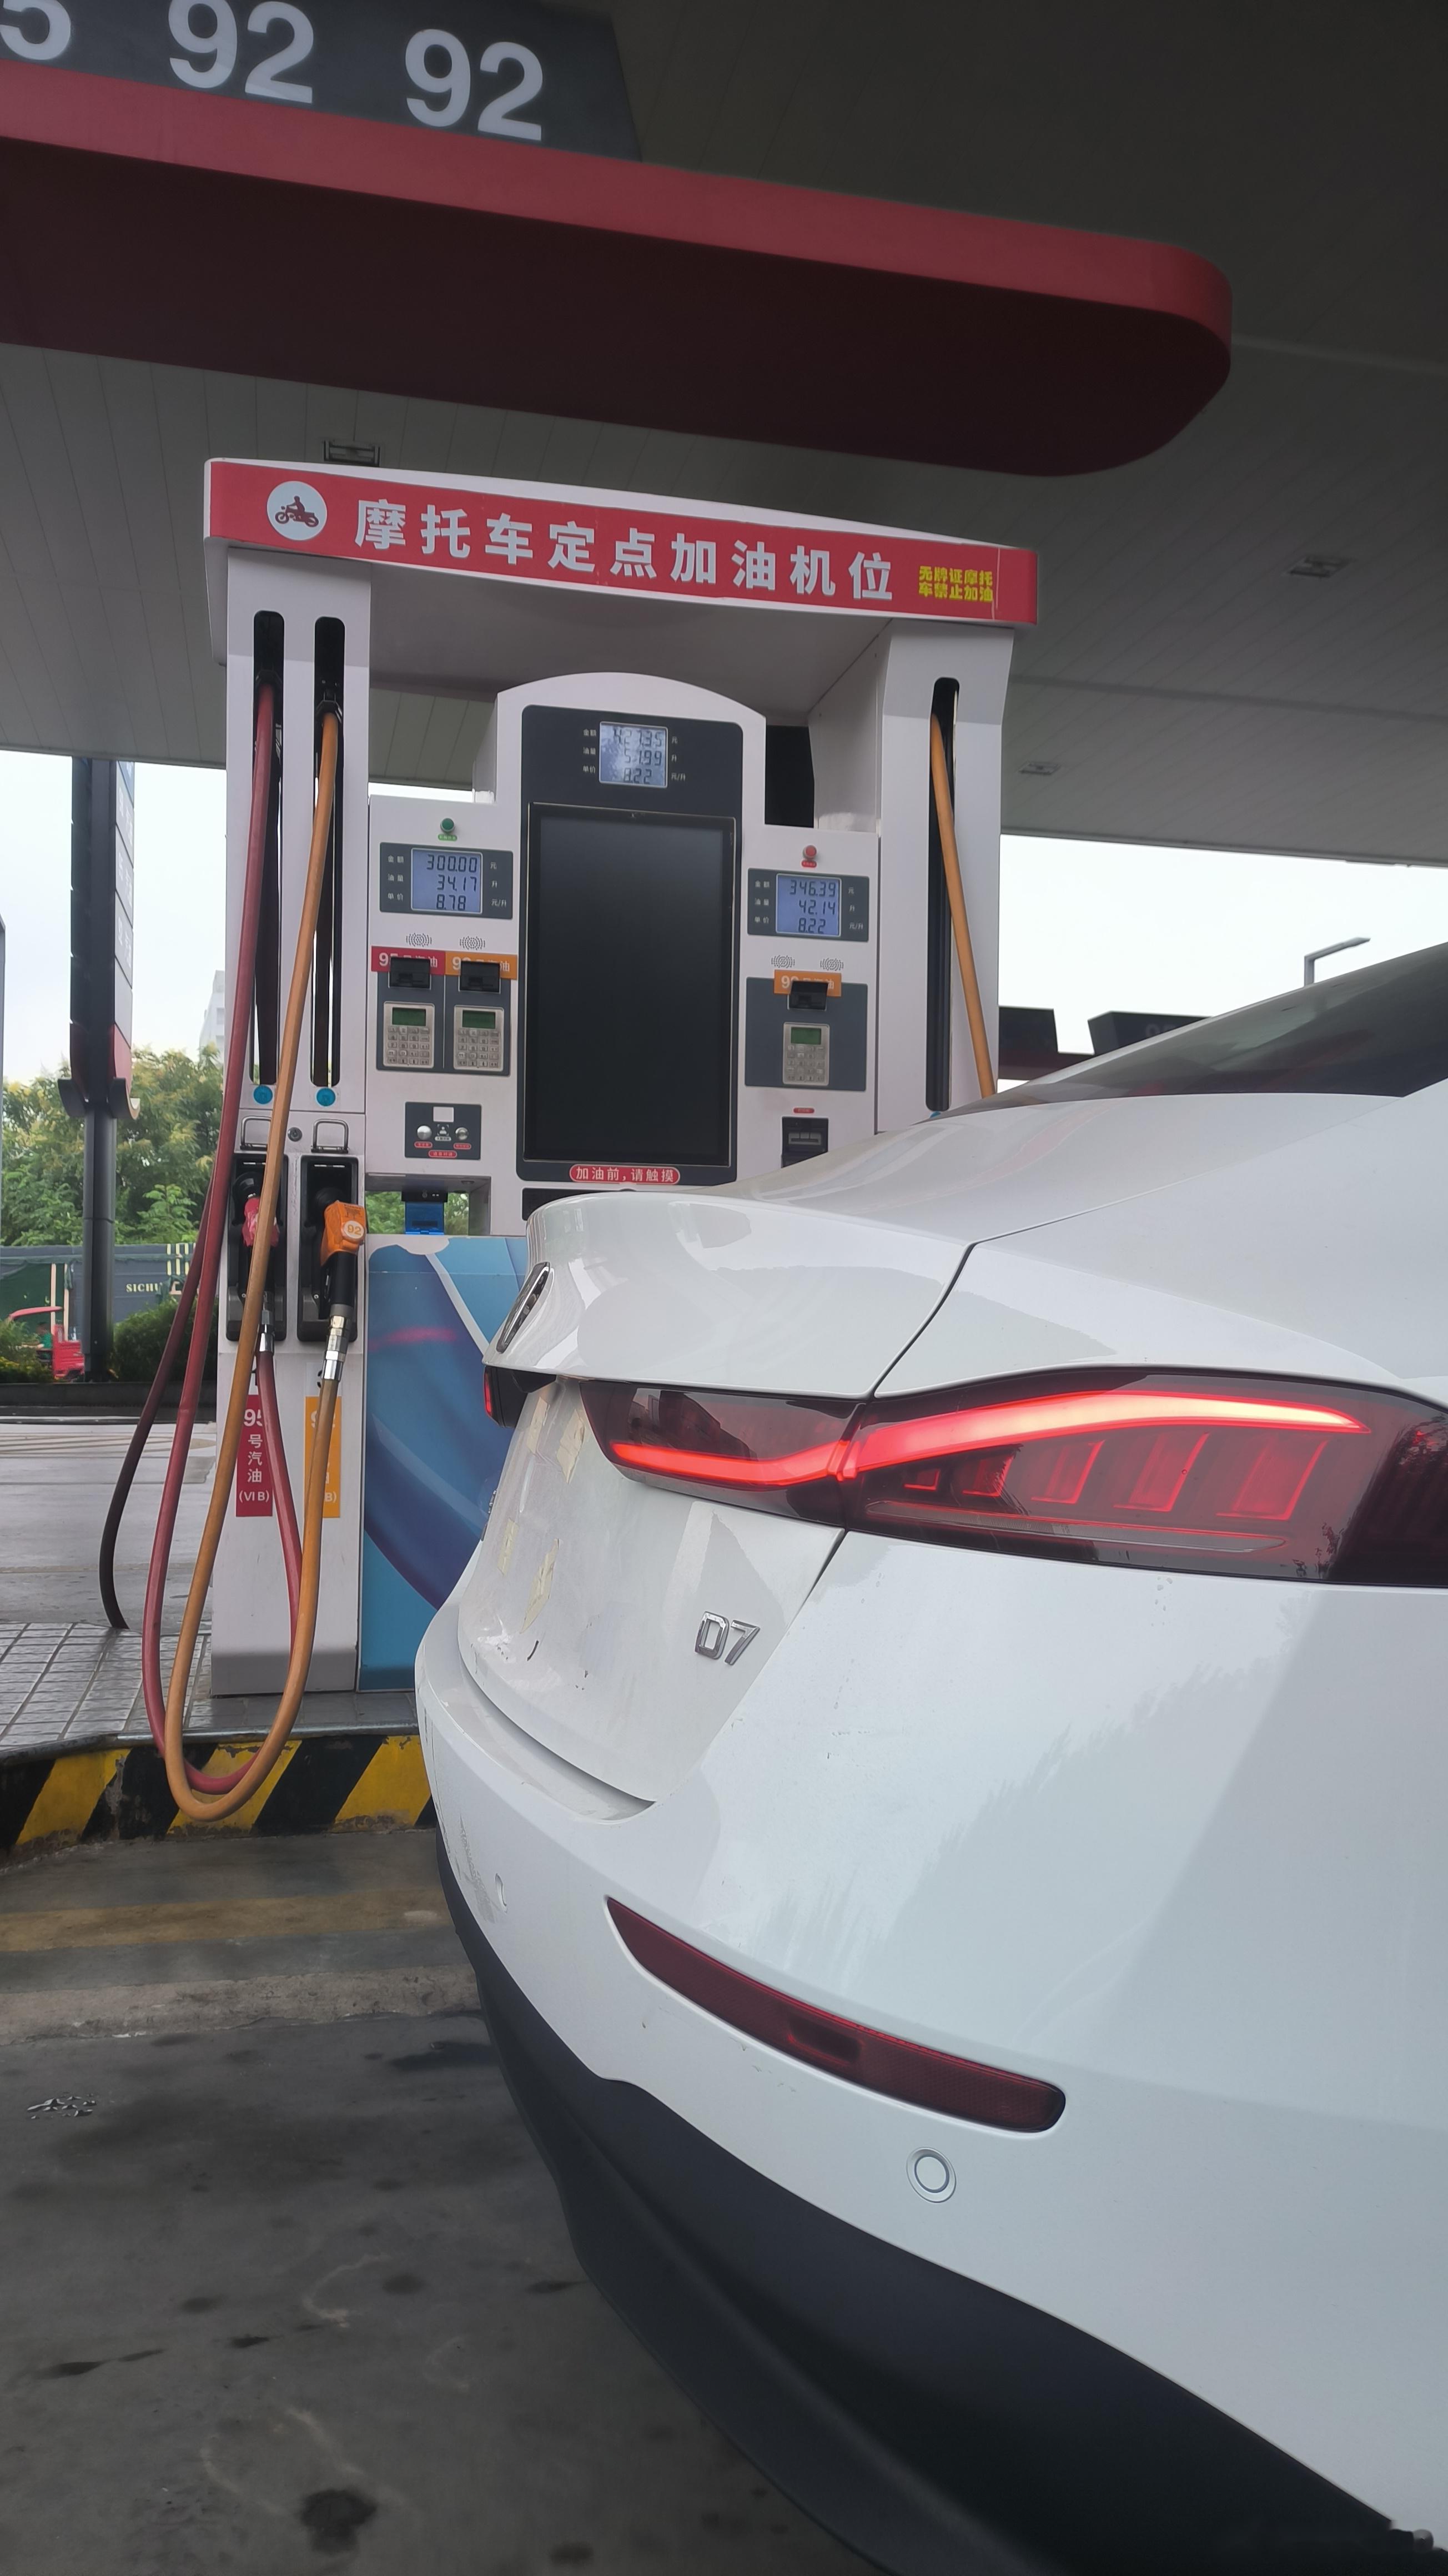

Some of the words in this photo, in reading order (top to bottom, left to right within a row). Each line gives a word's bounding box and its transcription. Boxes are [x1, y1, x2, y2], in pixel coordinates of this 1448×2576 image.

[168, 0, 314, 104] 92
[405, 28, 543, 141] 92
[354, 499, 893, 600] 摩托车定点加油机位
[919, 566, 993, 586] 无牌证摩托
[919, 581, 993, 602] 车禁止加油
[623, 767, 652, 785] 8.22
[426, 854, 477, 873] 300.00
[436, 874, 477, 892] 34.17
[790, 879, 836, 897] 346.39
[436, 894, 466, 911] 8.78
[799, 899, 836, 915] 42.14
[798, 918, 826, 934] 8.22
[347, 1224, 362, 1236] 92
[695, 1611, 761, 1666] D7
